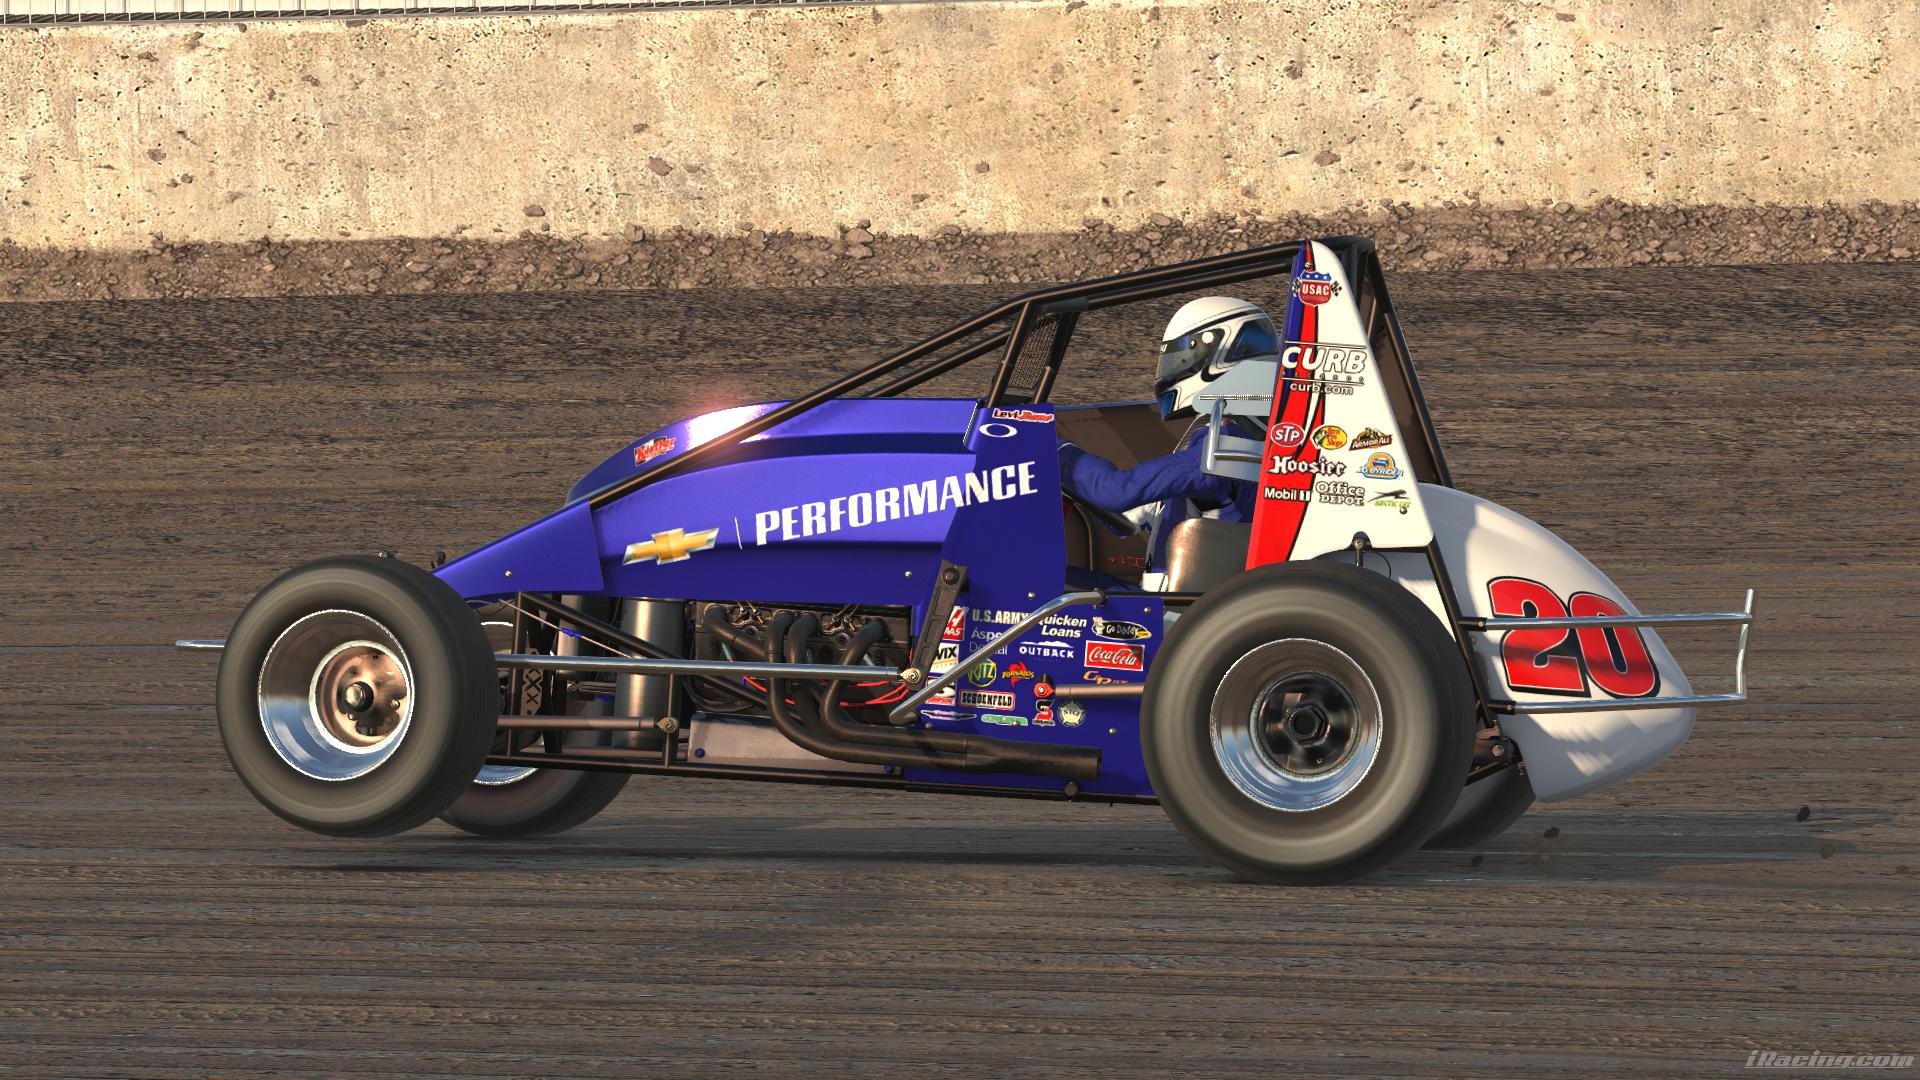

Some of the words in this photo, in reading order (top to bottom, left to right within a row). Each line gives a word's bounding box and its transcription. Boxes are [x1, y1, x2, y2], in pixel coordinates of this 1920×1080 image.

[1302, 284, 1330, 296] USAC
[1281, 346, 1368, 374] CURB
[1289, 383, 1354, 396] curb.com
[993, 408, 1019, 419] Levi
[1274, 425, 1301, 443] STP
[1268, 455, 1347, 477] Hoosier
[1264, 486, 1297, 501] Mobil
[1315, 481, 1366, 497] Office
[755, 461, 1038, 546] PERFORMANCE
[1319, 494, 1365, 507] DEPOT
[1039, 615, 1088, 628] uicken
[943, 627, 961, 637] AAS
[971, 628, 1003, 642] Aspe
[1041, 625, 1082, 638] Loans
[1486, 576, 1661, 699] 20
[1019, 646, 1074, 659] OUTBACK
